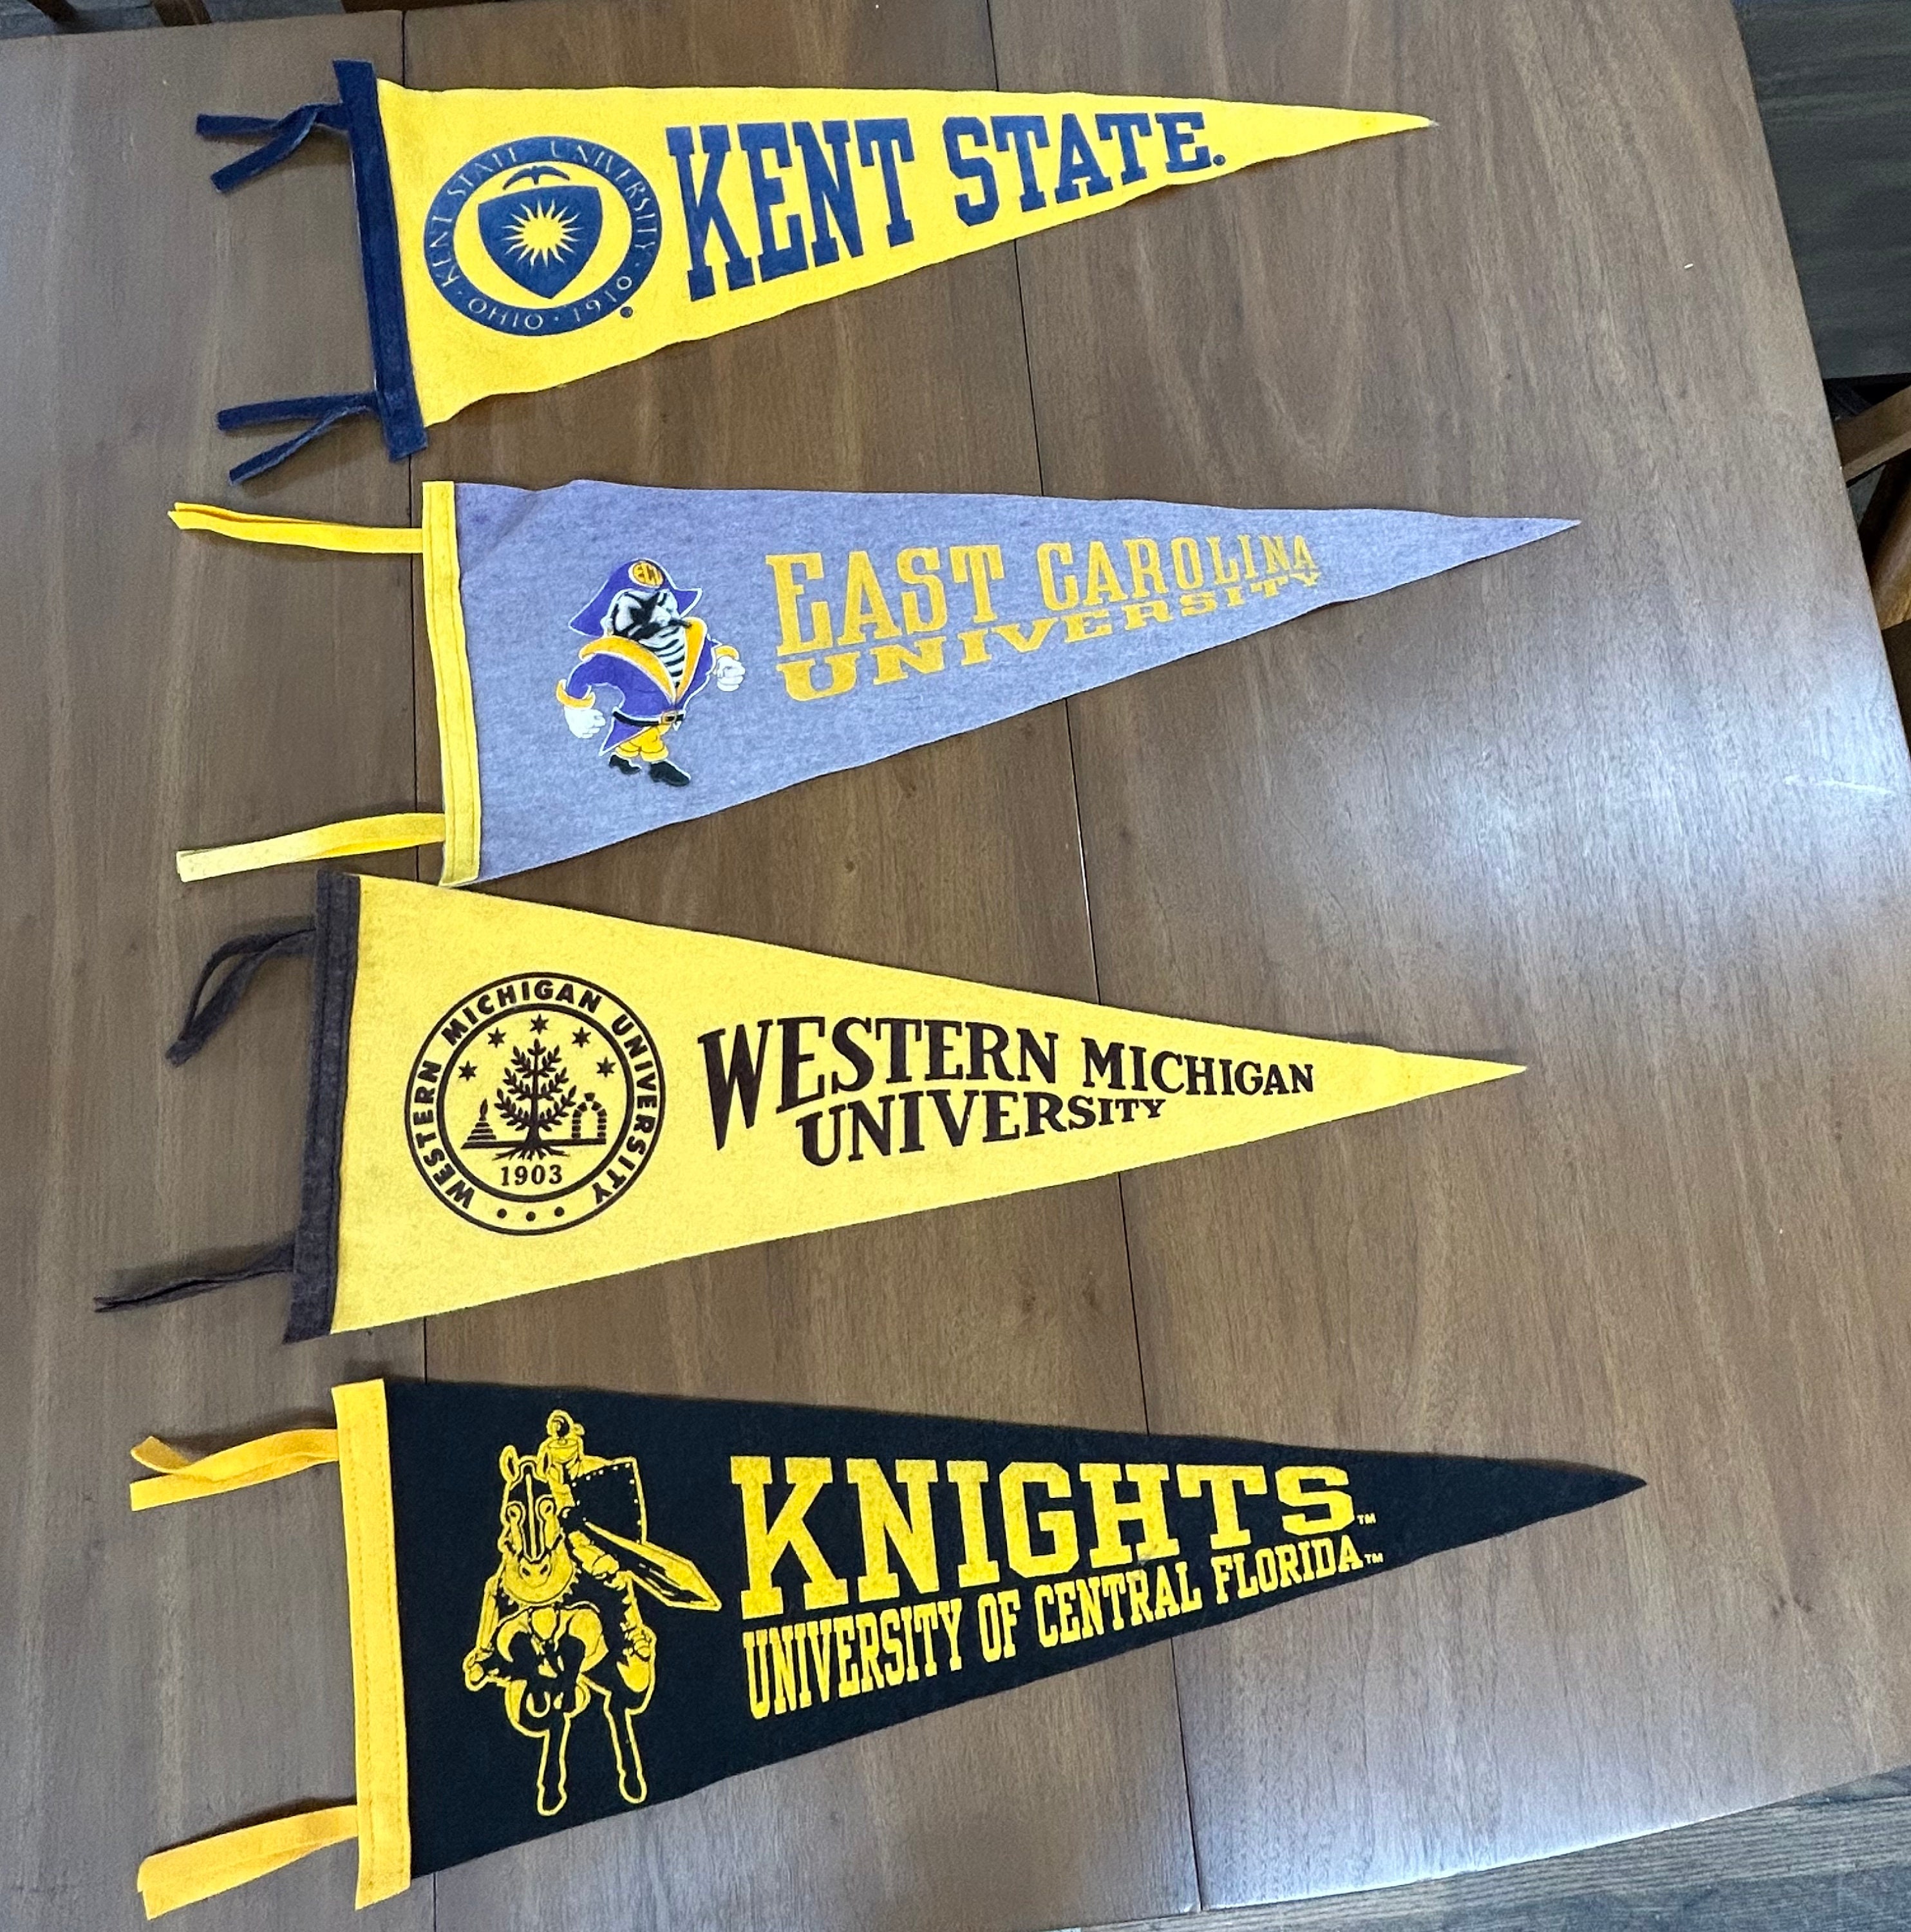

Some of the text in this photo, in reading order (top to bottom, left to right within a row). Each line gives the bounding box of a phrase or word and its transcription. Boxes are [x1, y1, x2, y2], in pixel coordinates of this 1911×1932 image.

[666, 117, 915, 301] KENT
[467, 275, 633, 330] OHIO 1910
[765, 535, 1319, 657] EAST CAROLINA
[776, 571, 1321, 702] UNIVERSITY
[413, 980, 658, 1209] WESTERN MICHIGAN UNIVERSITY
[697, 1016, 1314, 1151] WESTERN MICHIGAN
[795, 1090, 1167, 1167] UNIVERSITY
[500, 1164, 563, 1186] 1903
[730, 1455, 1355, 1620] KNIGHTS
[742, 1598, 963, 1719] UNIVERSITY
[977, 1589, 1021, 1662] OF
[1034, 1560, 1203, 1648] CENTRAL
[1212, 1535, 1364, 1604] FLORIDA
